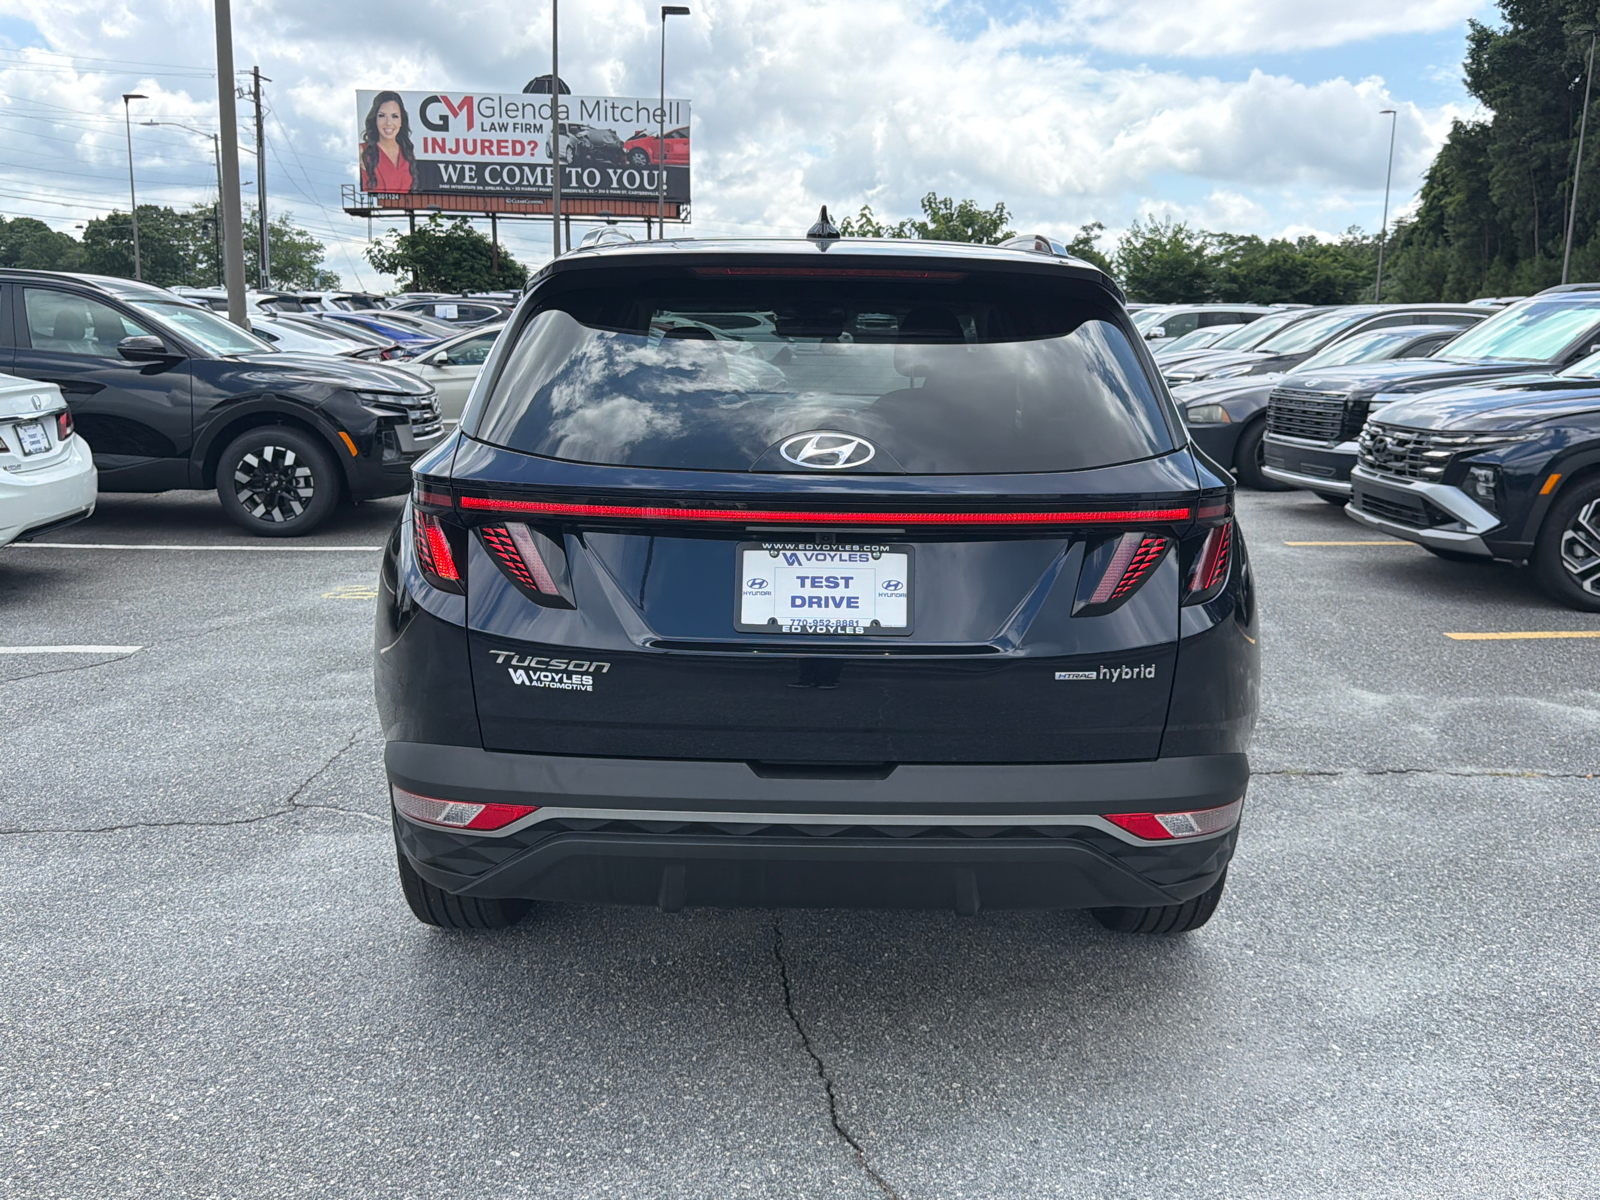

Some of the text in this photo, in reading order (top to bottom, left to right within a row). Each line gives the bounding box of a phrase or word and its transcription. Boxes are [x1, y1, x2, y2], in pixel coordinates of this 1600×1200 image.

[477, 95, 570, 120] Glenda
[580, 99, 680, 125] Mitchell
[480, 121, 544, 134] LAW FIRM
[423, 136, 539, 158] INJURED?
[437, 163, 478, 184] WE
[565, 167, 601, 188] TO
[606, 168, 668, 190] YOU!
[762, 543, 890, 552] WWW.EDVOYLES.COM
[803, 552, 870, 563] VOYLES
[796, 576, 854, 589] TEST
[790, 595, 860, 609] DRIVE
[782, 625, 865, 634] ED VOYLES
[790, 619, 860, 627] 770-952-8881
[529, 670, 593, 685] VOYLES
[1057, 664, 1156, 683] HTRAC hybrid
[531, 680, 593, 692] AUTOMOTIVE
